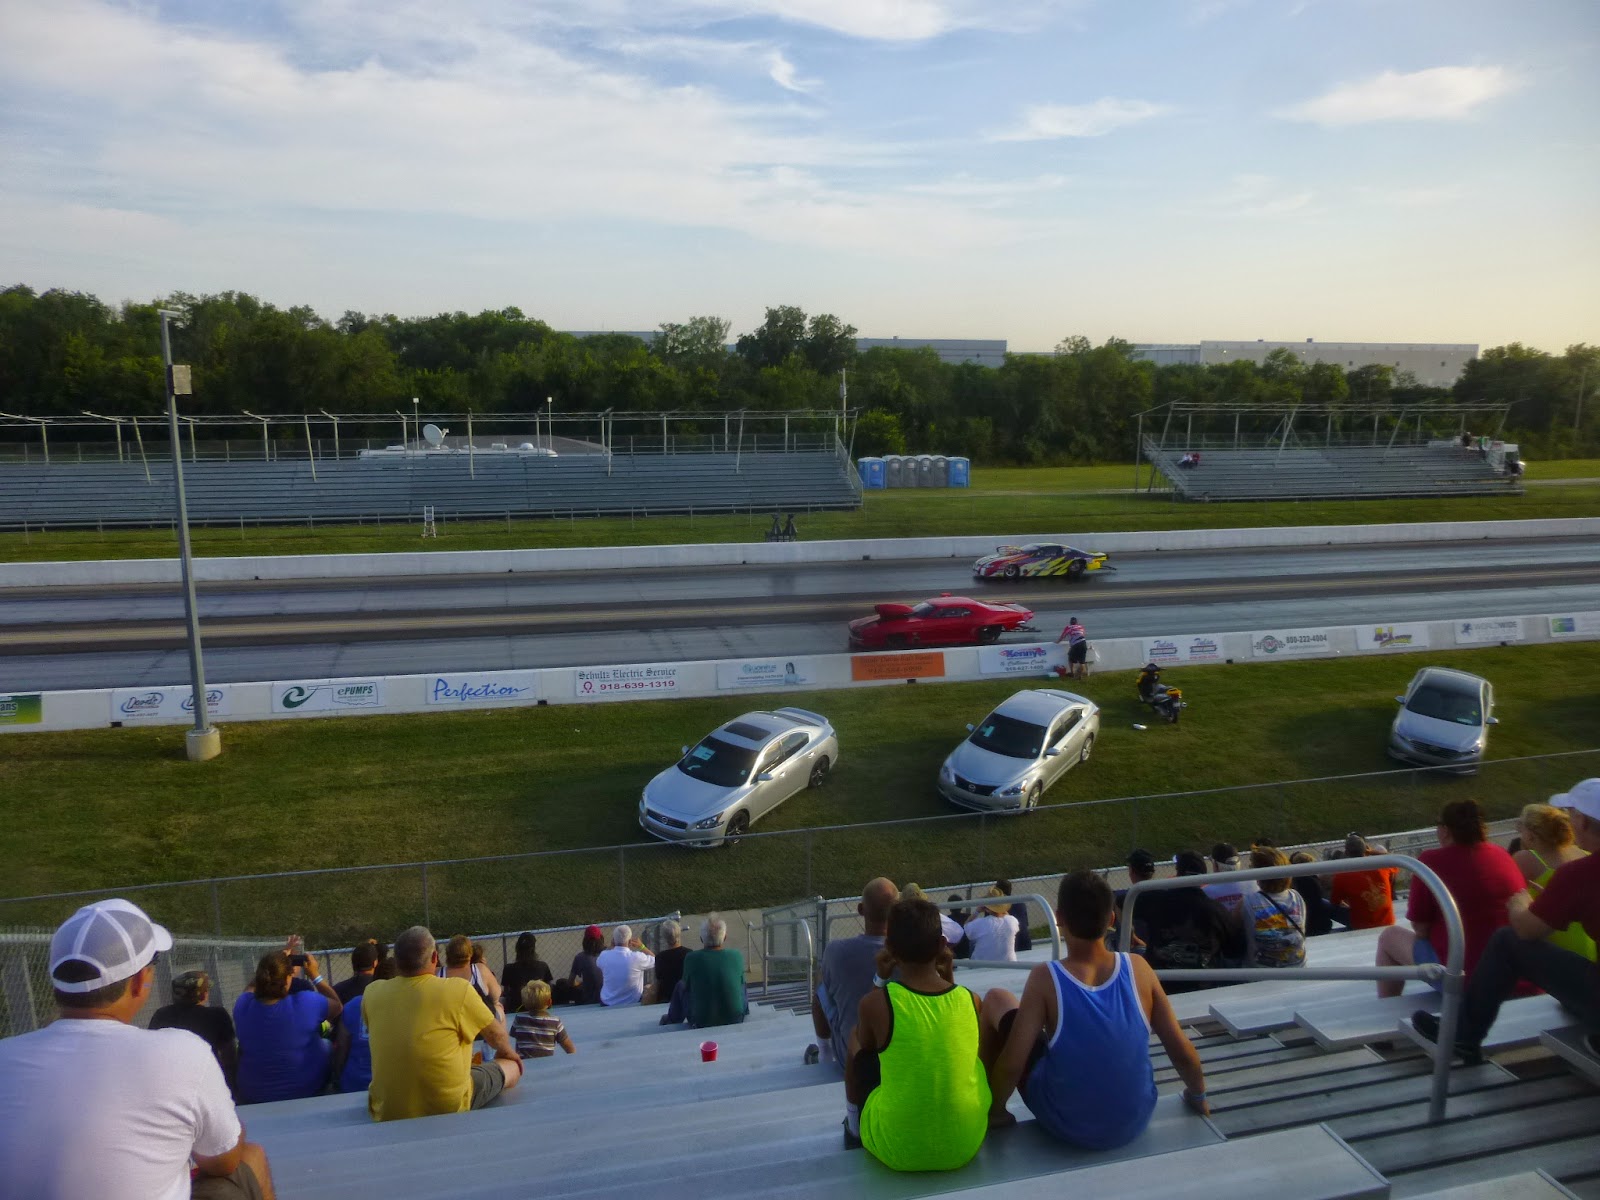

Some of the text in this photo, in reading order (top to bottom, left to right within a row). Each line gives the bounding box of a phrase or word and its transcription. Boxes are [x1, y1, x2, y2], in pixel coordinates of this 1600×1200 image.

[578, 670, 611, 681] Schultz
[612, 669, 643, 679] Electric
[646, 667, 677, 677] Service
[337, 685, 373, 695] ePUMPS
[433, 678, 530, 701] Perfection
[600, 680, 675, 690] 918-639-1319
